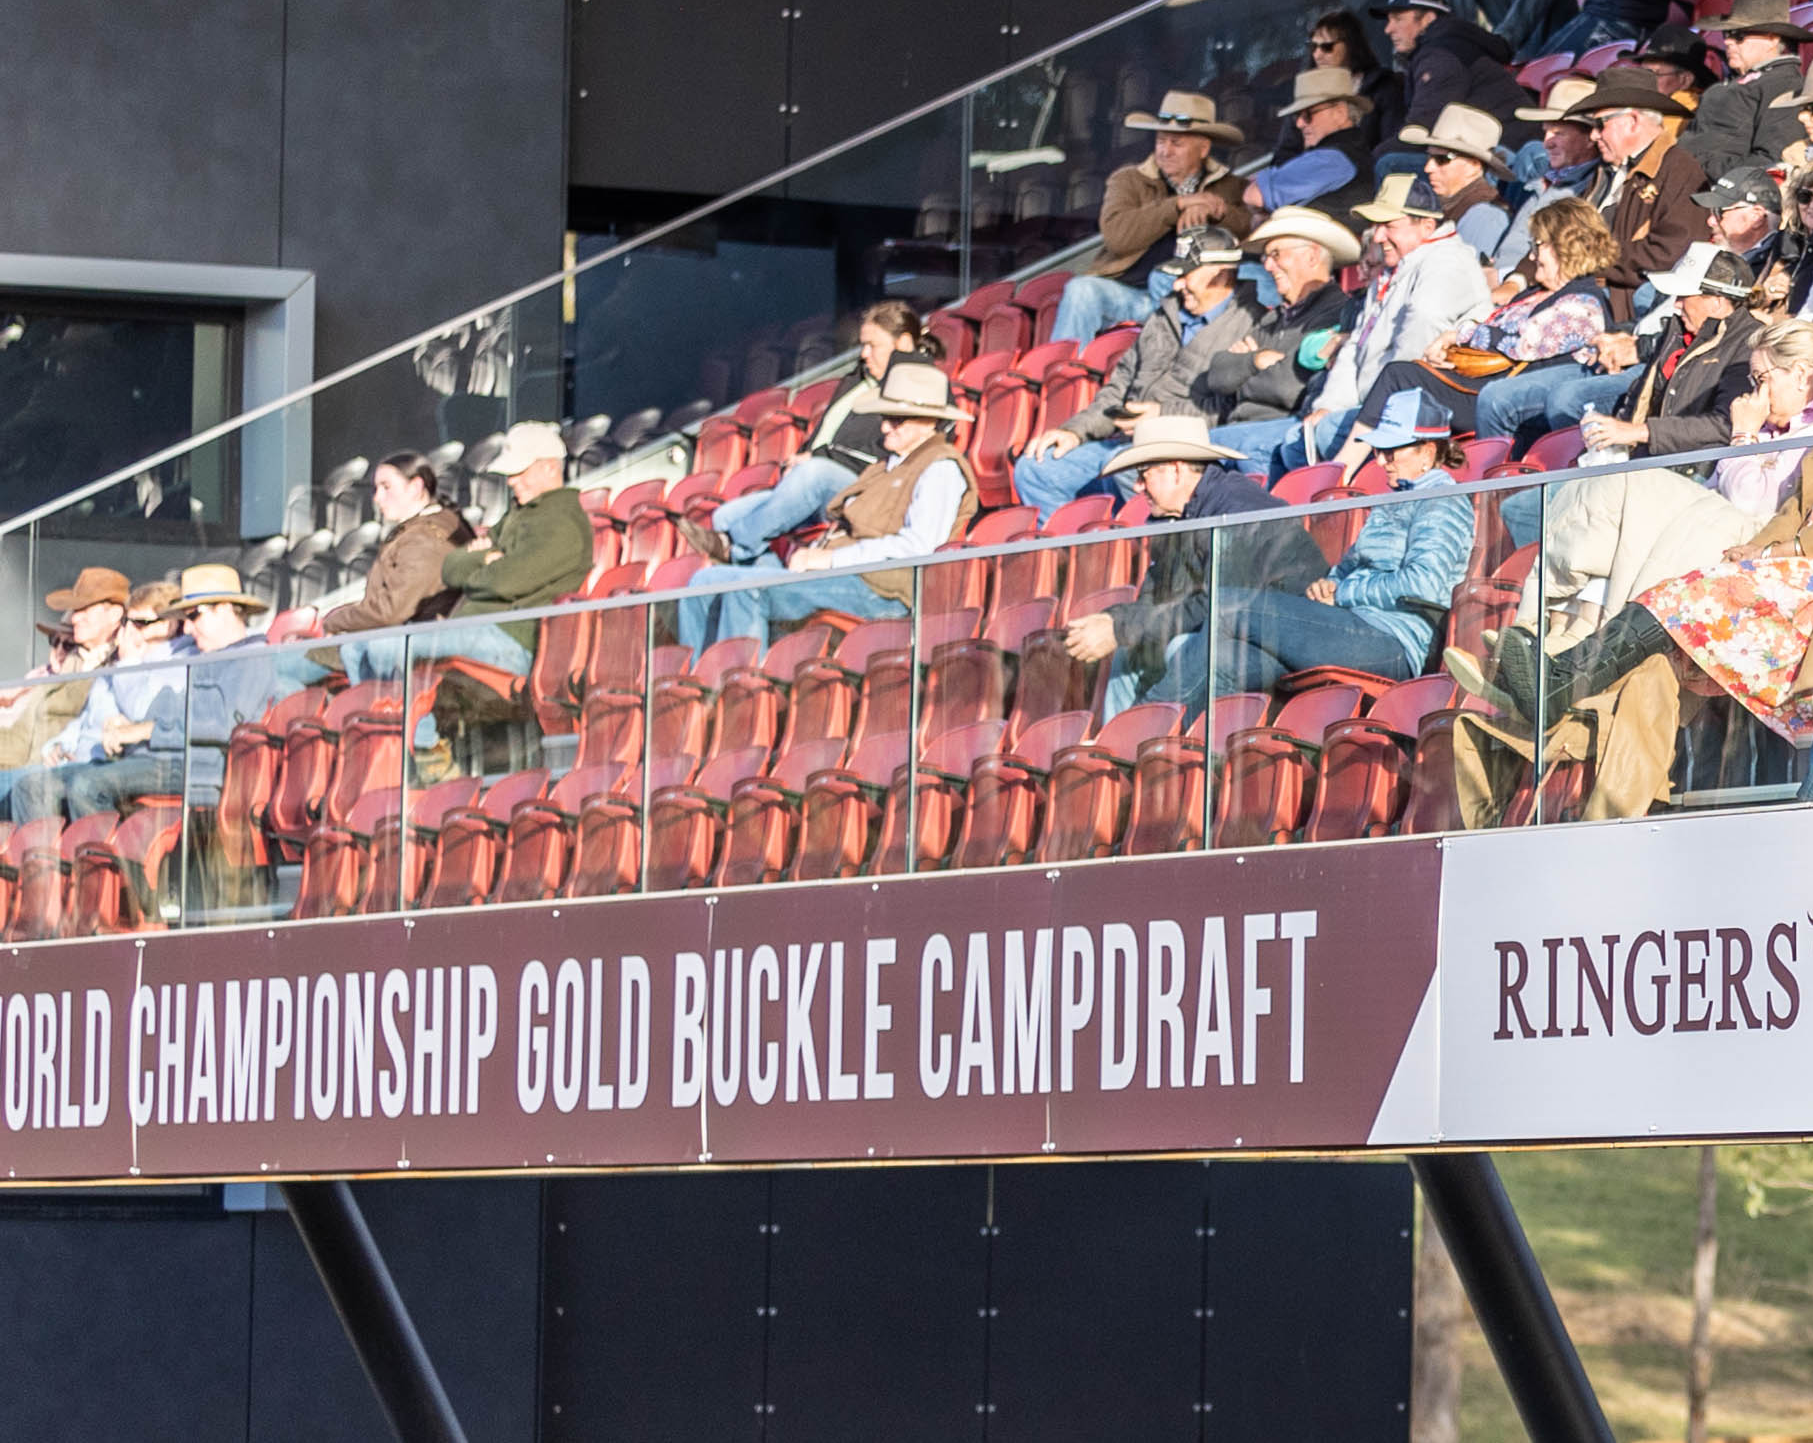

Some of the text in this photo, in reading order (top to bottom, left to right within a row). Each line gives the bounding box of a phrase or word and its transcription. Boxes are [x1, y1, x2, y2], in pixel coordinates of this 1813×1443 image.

[0, 910, 1317, 1132] ORLD CHAMPIONSHIP GOLD BUCKLE CAMPDRAFT
[1493, 921, 1800, 1041] RINGERS
